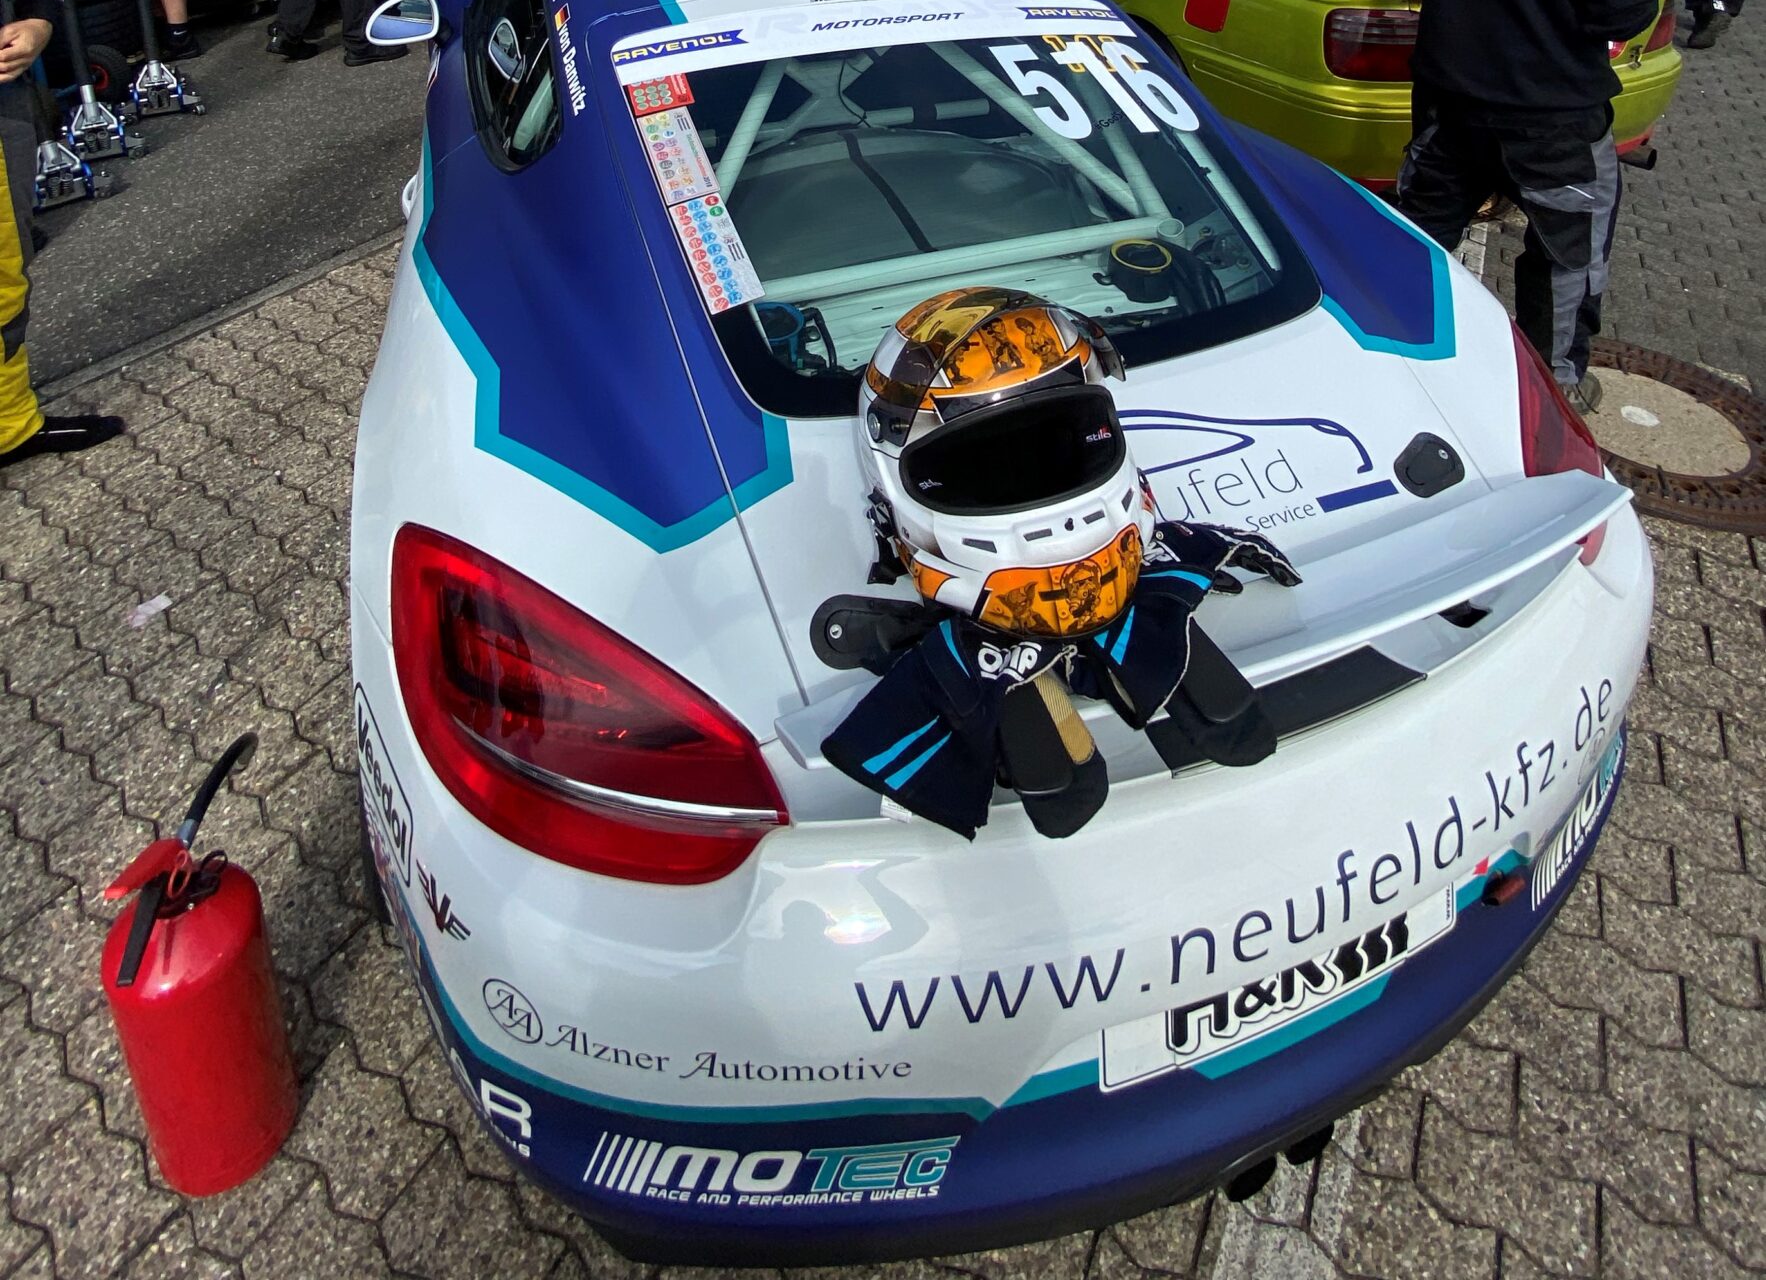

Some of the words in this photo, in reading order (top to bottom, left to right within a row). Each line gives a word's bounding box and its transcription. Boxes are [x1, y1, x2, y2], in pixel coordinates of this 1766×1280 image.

[810, 11, 963, 32] MOTORSPORT
[1027, 7, 1118, 19] RAVENOL
[558, 23, 572, 53] von
[612, 32, 733, 63] RAVENOL
[562, 44, 586, 117] Danwitz
[988, 41, 1200, 140] 516
[1085, 428, 1112, 443] stilo
[1155, 448, 1303, 523] ufeld
[1245, 502, 1317, 533] Service
[356, 701, 408, 866] Veedol
[854, 677, 1613, 1032] www.neufeld-kfz.de
[544, 1024, 671, 1073] Alzner
[678, 1051, 913, 1083] Automotive
[645, 1186, 691, 1202] RACE
[697, 1194, 732, 1205] AND
[737, 1191, 864, 1206] PERFORMANCE
[869, 1184, 941, 1202] WHEELS
